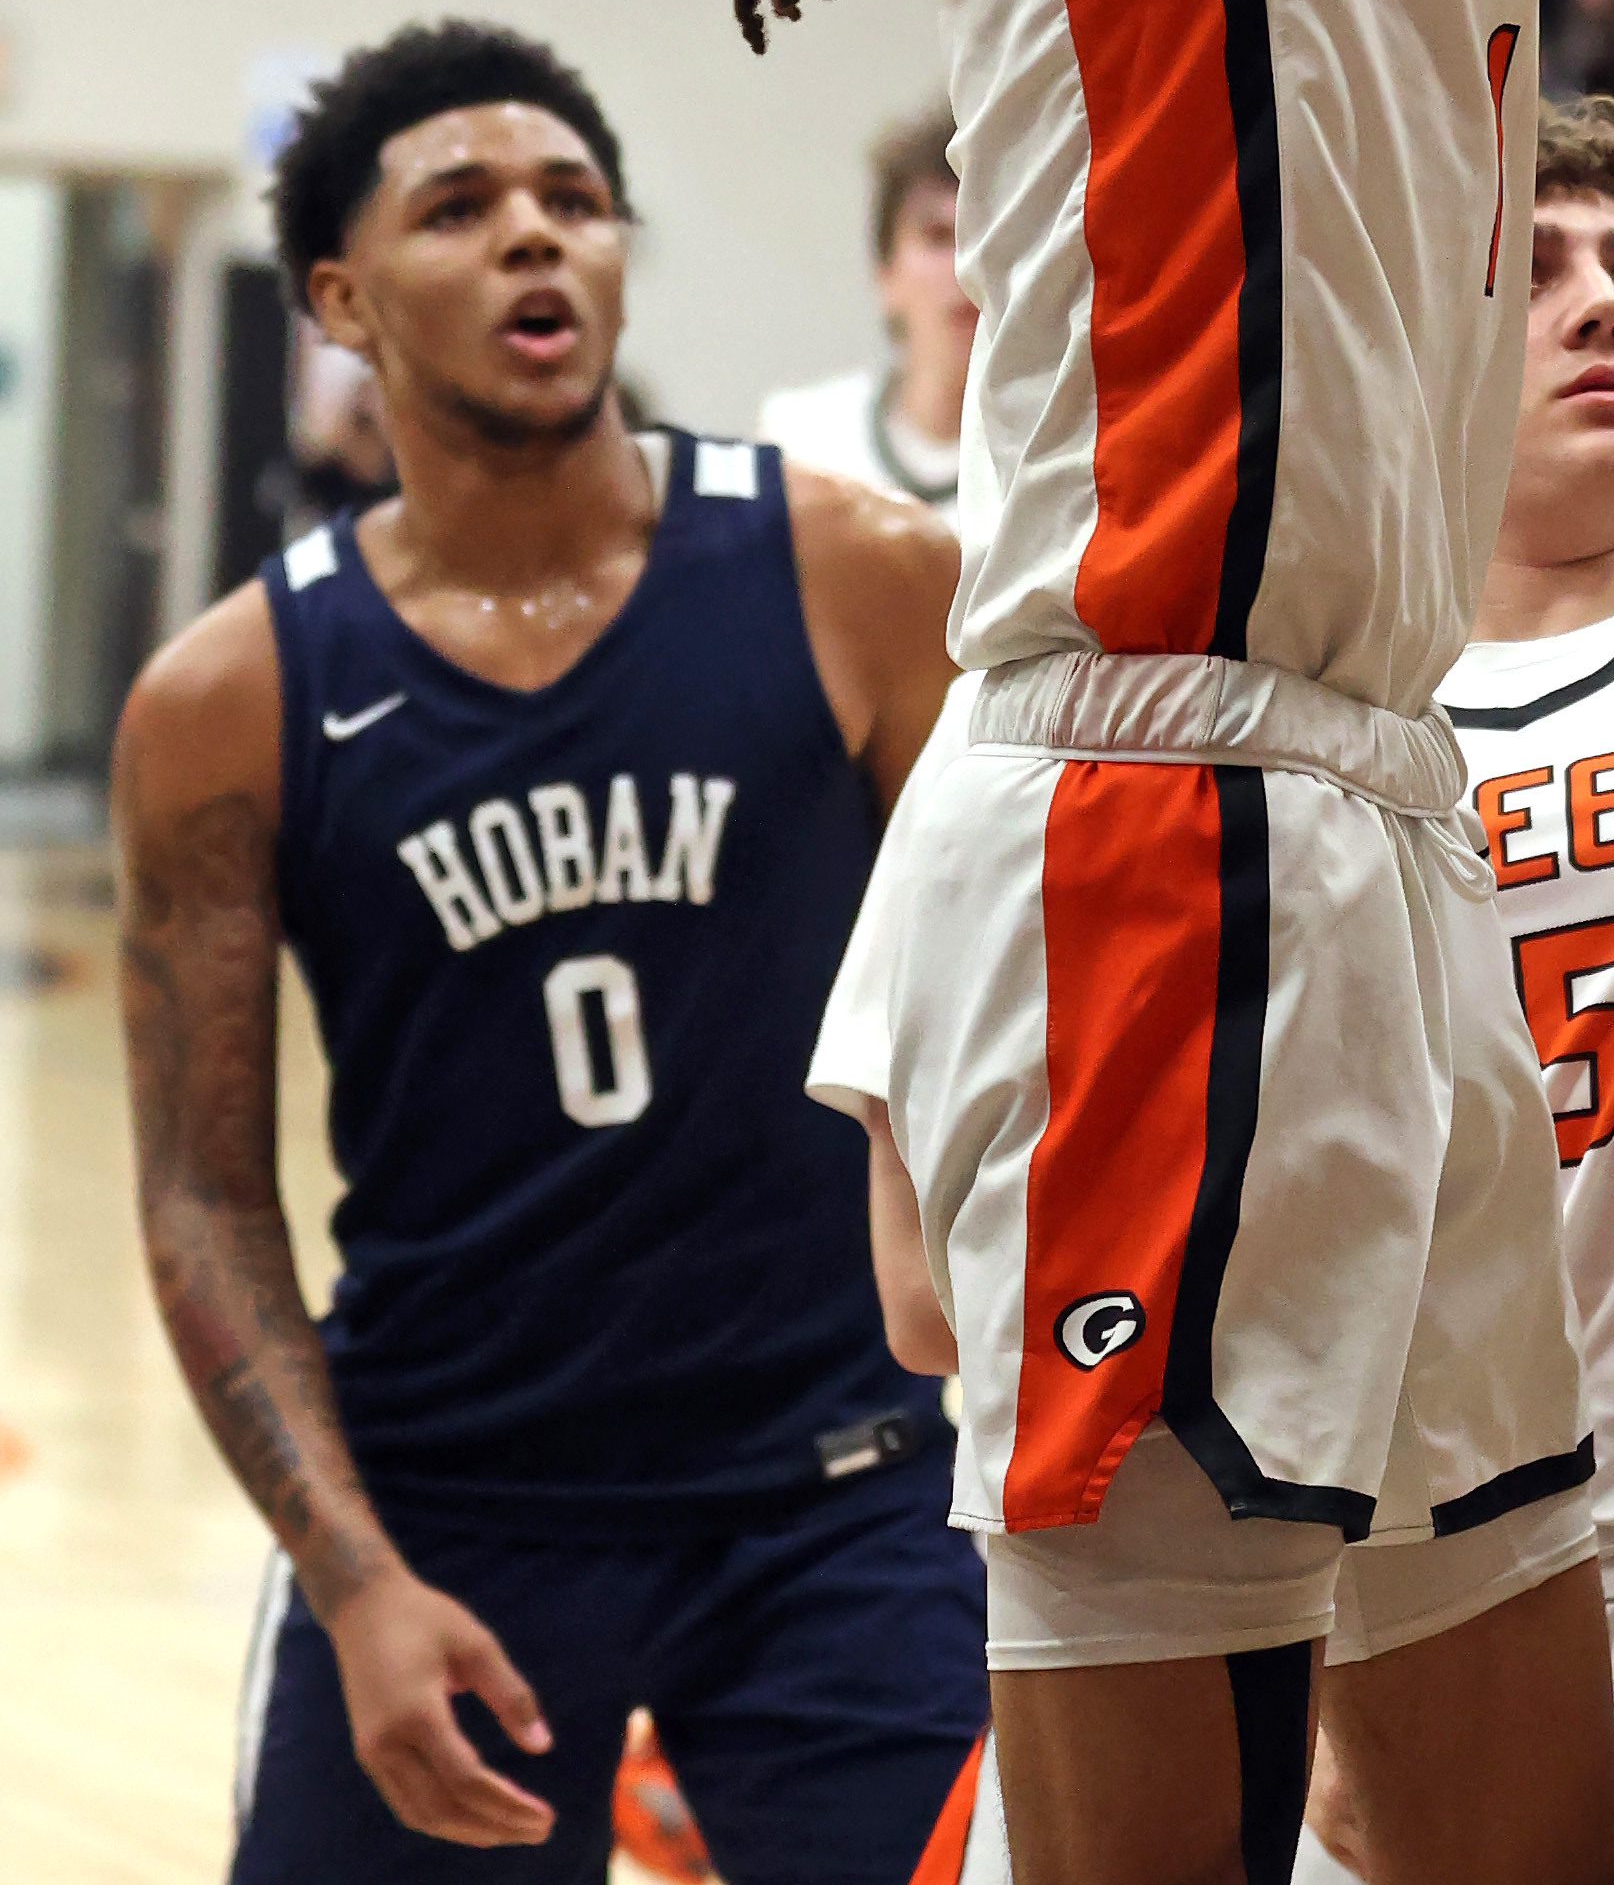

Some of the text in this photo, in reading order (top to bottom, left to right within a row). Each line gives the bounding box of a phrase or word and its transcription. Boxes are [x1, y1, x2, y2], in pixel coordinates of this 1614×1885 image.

[398, 771, 737, 952] HOBAN
[543, 954, 653, 1129] 0
[1055, 1290, 1145, 1371] G
